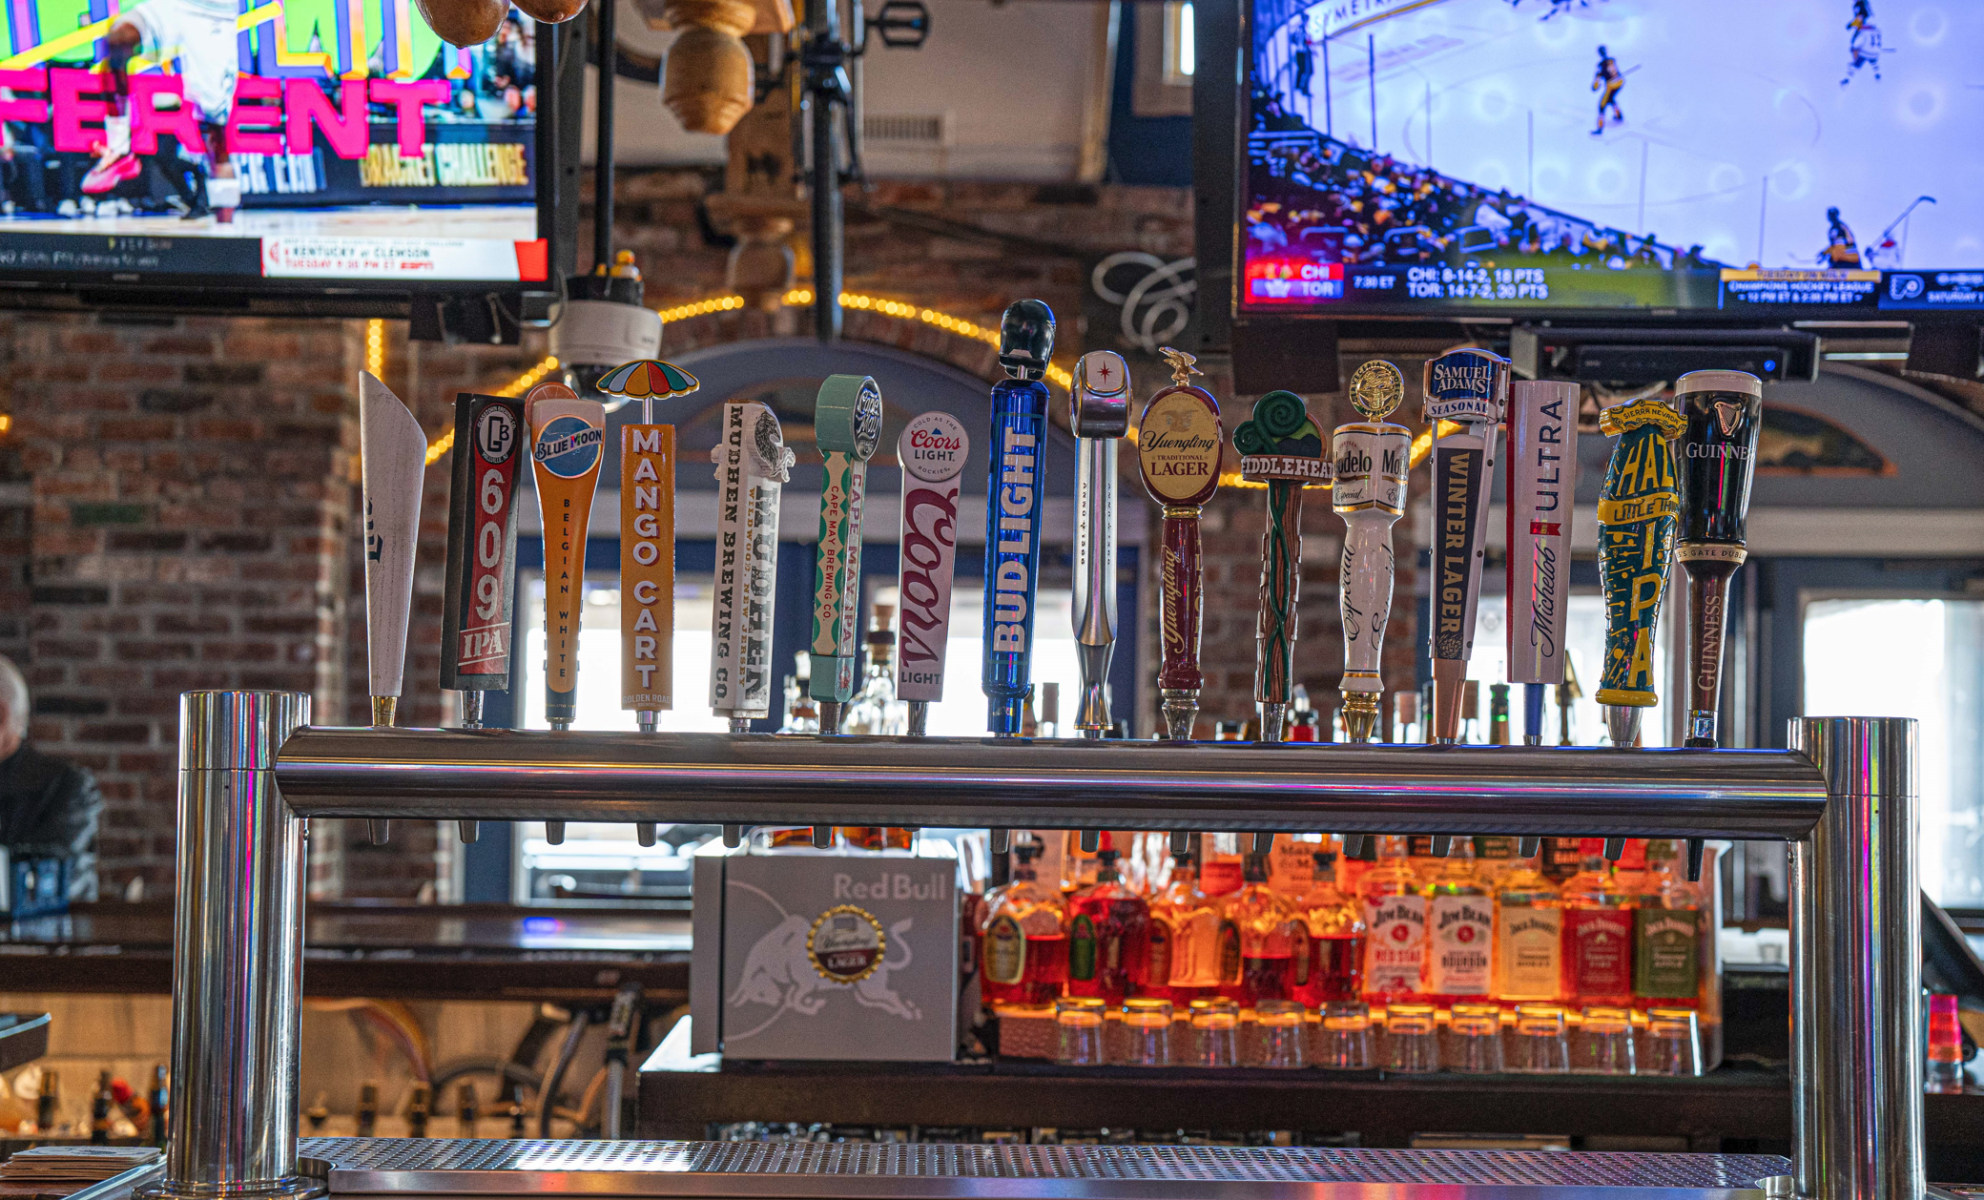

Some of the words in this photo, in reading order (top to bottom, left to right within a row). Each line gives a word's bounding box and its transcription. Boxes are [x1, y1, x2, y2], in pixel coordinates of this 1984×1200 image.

[1301, 264, 1330, 280] CHI
[1302, 281, 1334, 296] TOR
[1514, 268, 1545, 284] PTS
[1518, 283, 1549, 299] PTS
[1434, 363, 1492, 381] SAMUEL
[1436, 378, 1486, 394] ADAMS
[1431, 401, 1486, 415] SEASONAL
[1623, 408, 1650, 420] SIERRA
[1652, 409, 1679, 425] NEVADA
[535, 440, 568, 460] BLUE
[570, 430, 602, 448] MOON
[911, 429, 961, 450] Coors
[914, 449, 954, 461] LIGHT
[1141, 430, 1219, 453] Yuengling
[1536, 397, 1563, 511] ULTRA
[1151, 462, 1209, 476] LAGER
[1336, 449, 1373, 474] odelo
[1616, 432, 1680, 496] HAZ
[632, 429, 662, 566] MANGO
[829, 485, 839, 517] CAPE
[850, 473, 862, 535] CAPE
[998, 426, 1036, 555] LIGHT
[1445, 452, 1470, 549] WINTER
[1614, 498, 1656, 522] LITTLE
[475, 468, 505, 620] 609
[560, 499, 570, 594] BELGIAN
[828, 521, 838, 545] MAY
[1690, 549, 1716, 557] GATE
[824, 548, 835, 600] BREWING
[846, 545, 857, 594] MAY
[902, 487, 959, 668] Coors
[717, 532, 736, 658] BREWING
[823, 604, 832, 622] CO.
[993, 560, 1028, 653] BUD
[1164, 544, 1184, 654] Yuengling
[1440, 556, 1464, 633] LAGER
[1531, 542, 1557, 658] Michelob
[1627, 521, 1661, 688] IPA
[462, 629, 504, 659] IPA
[559, 611, 569, 678] WHITE
[633, 580, 661, 689] CART
[1697, 595, 1721, 691] GUINNESS
[739, 624, 748, 687] JERSEY
[901, 671, 941, 685] LIGHT
